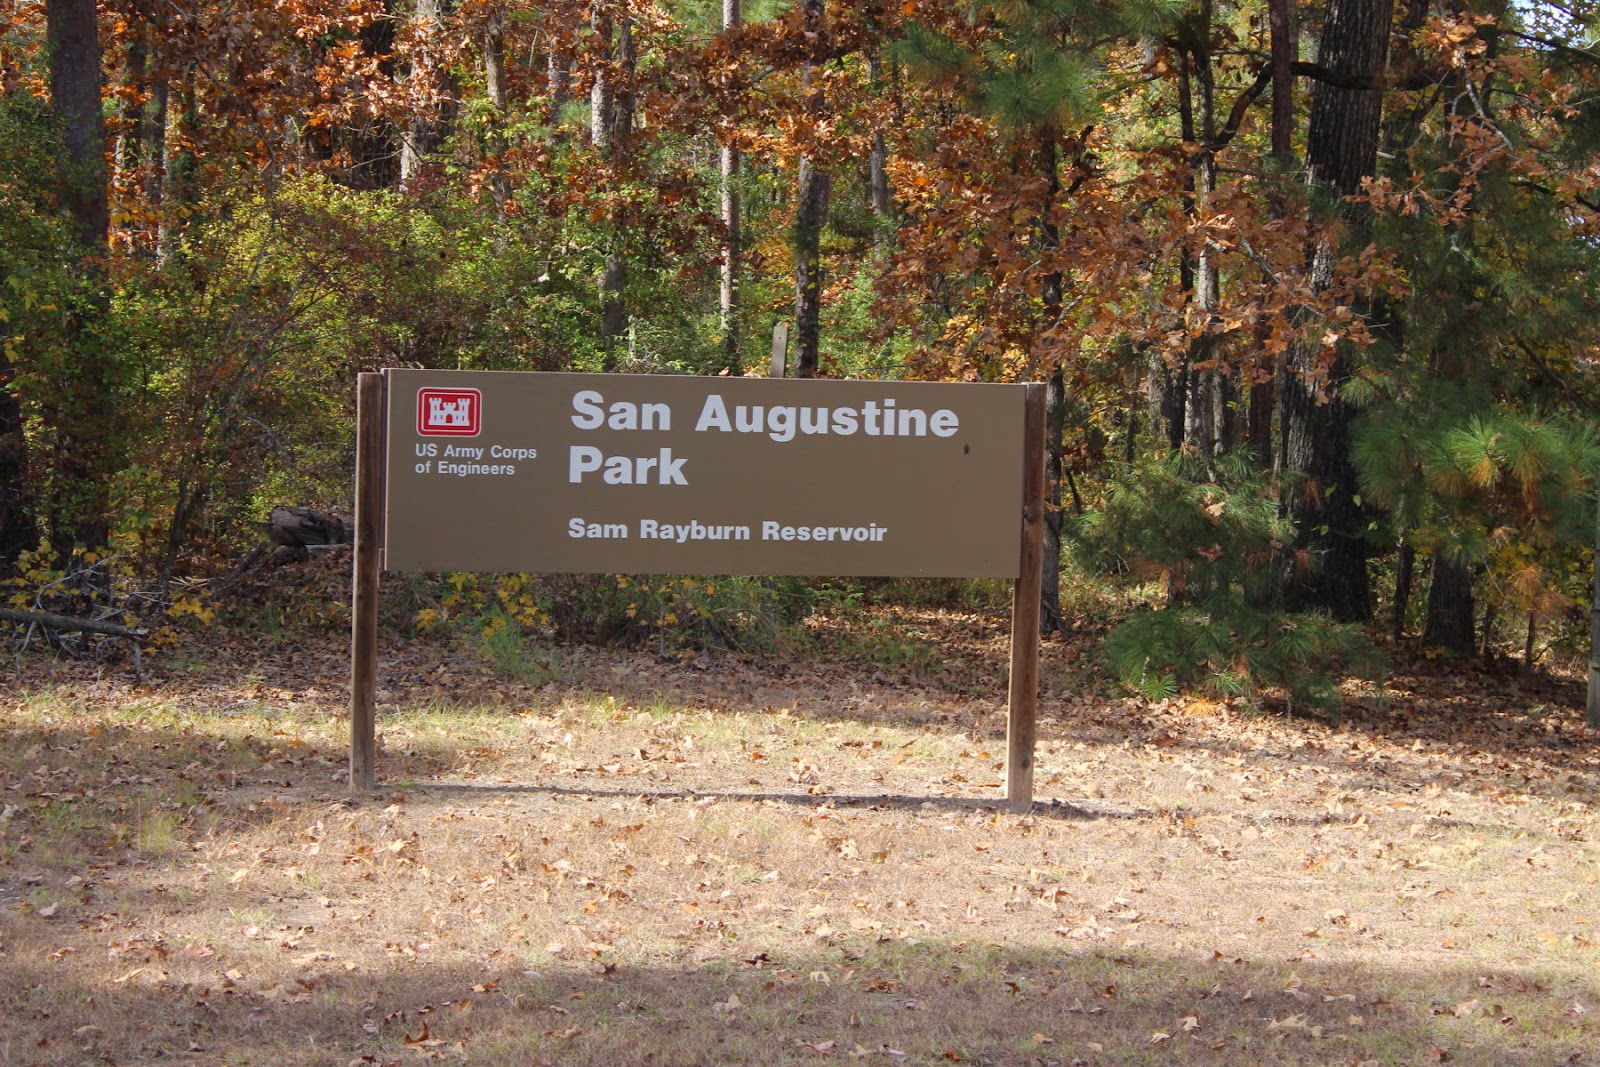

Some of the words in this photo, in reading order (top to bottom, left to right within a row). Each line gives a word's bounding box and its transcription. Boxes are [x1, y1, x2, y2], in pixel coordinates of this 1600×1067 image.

[570, 390, 671, 431] San
[694, 394, 960, 443] Augustine
[415, 443, 438, 457] US
[443, 444, 484, 460] Army
[490, 445, 537, 461] Corps
[569, 445, 689, 486] Park
[415, 461, 431, 474] of
[438, 461, 515, 477] Engineers
[568, 517, 628, 540] Sam
[640, 519, 750, 544] Rayburn
[762, 520, 888, 542] Reservoir
